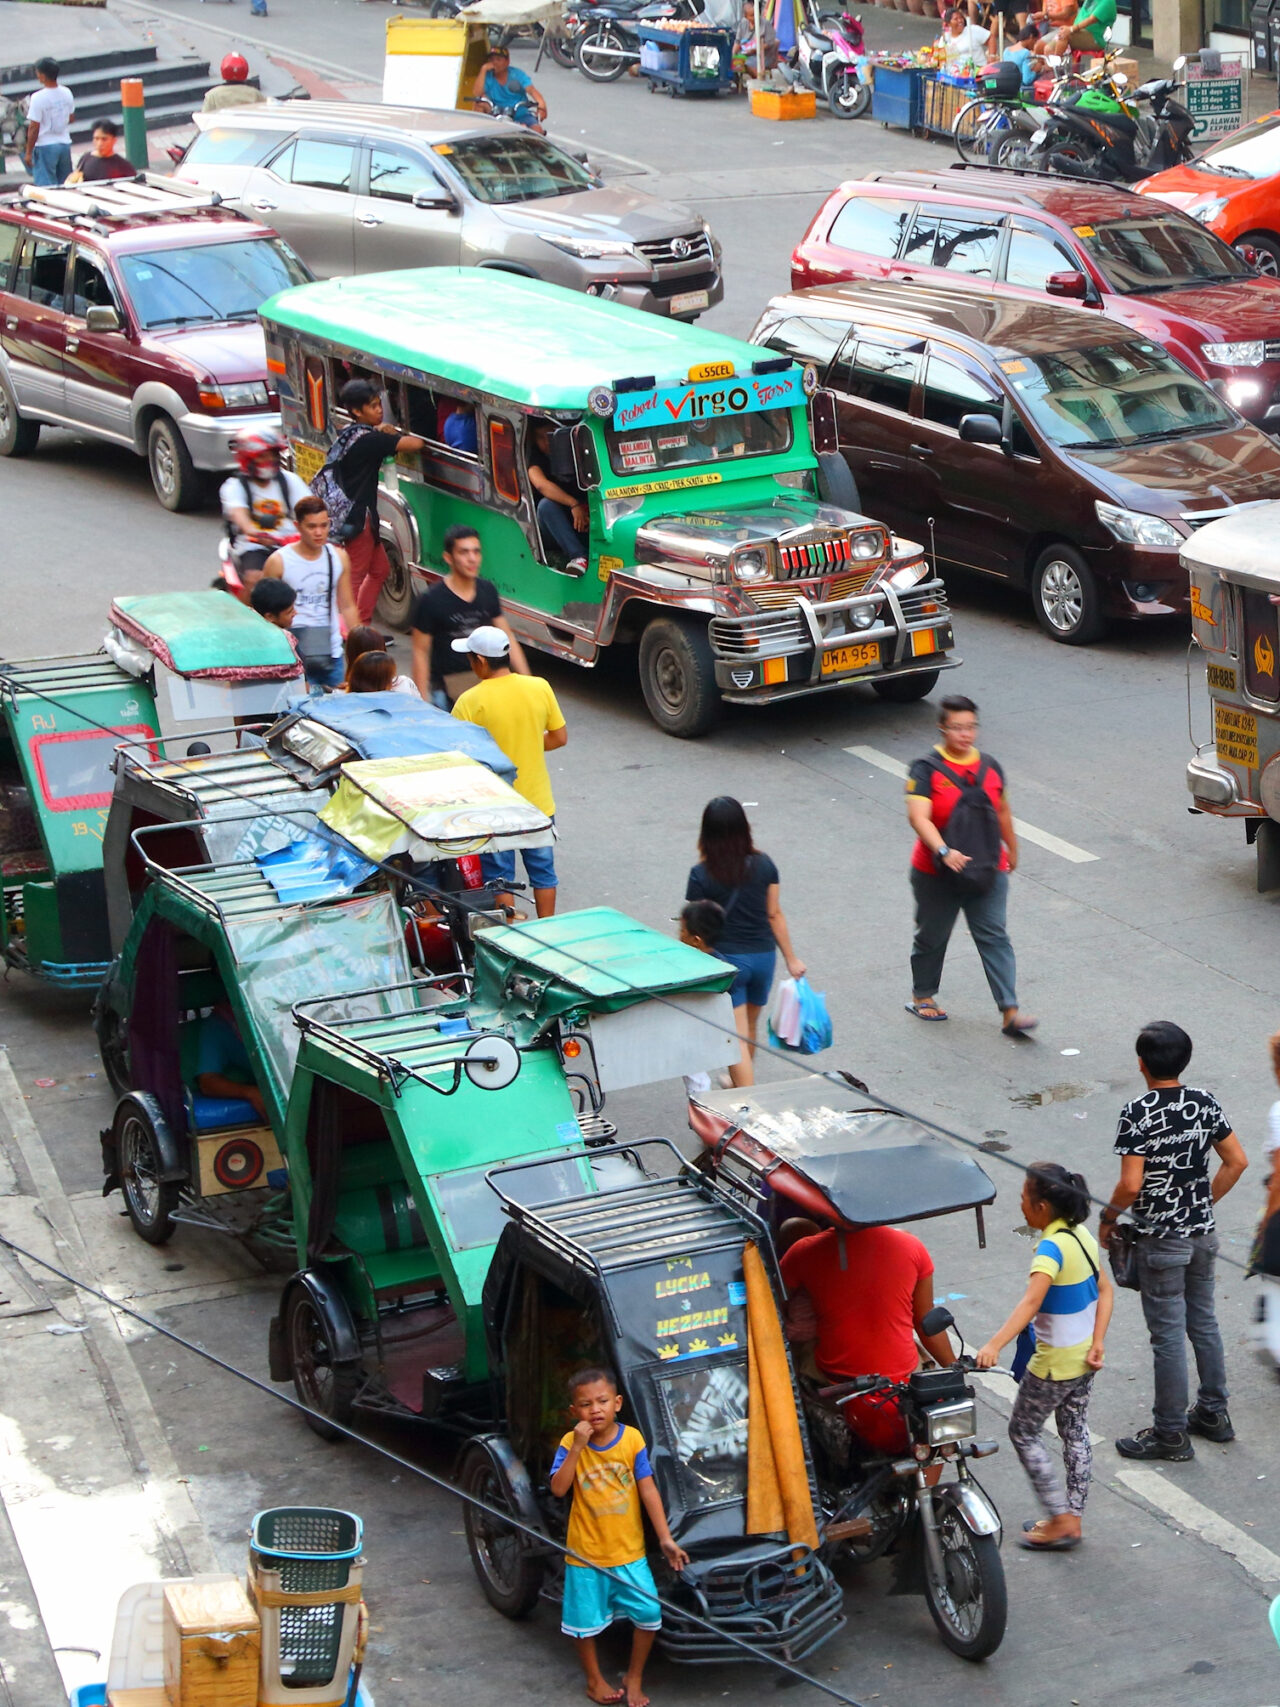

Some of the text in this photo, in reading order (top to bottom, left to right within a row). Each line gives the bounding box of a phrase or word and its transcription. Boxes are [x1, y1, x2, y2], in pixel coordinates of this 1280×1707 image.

[617, 392, 659, 426] Robert
[625, 455, 655, 467] MALINTA
[851, 644, 879, 662] 963
[656, 1307, 729, 1338] HEZZAM
